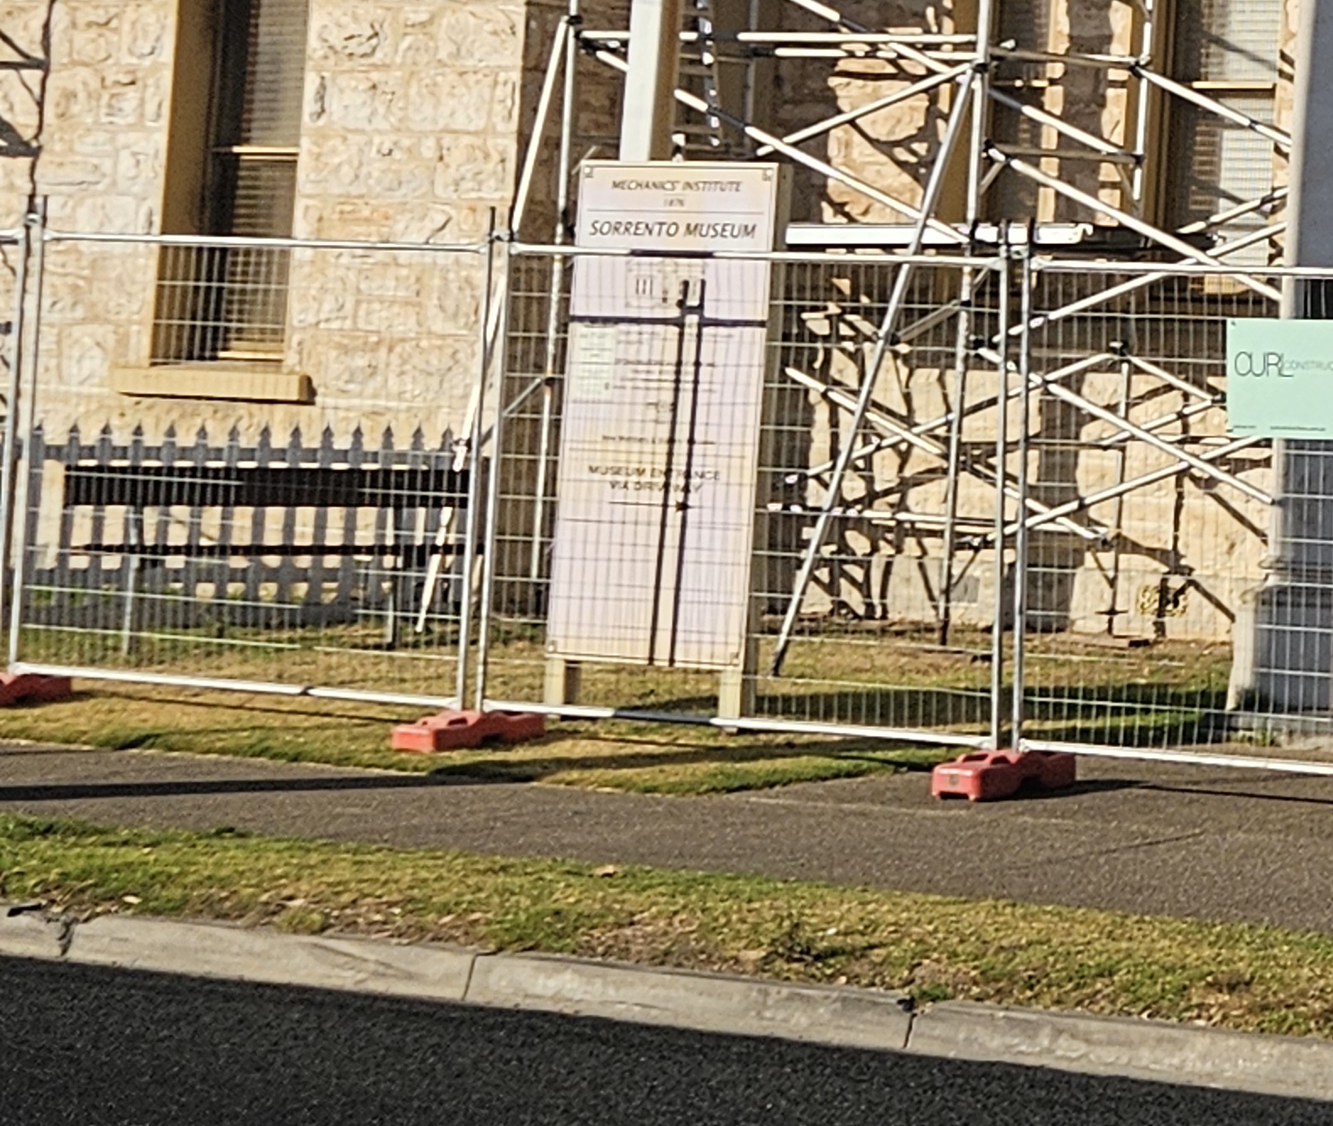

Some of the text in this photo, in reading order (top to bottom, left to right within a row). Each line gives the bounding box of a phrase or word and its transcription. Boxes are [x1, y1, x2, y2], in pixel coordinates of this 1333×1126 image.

[682, 181, 743, 192] INSTITUTE
[589, 220, 757, 239] SORRENTO MUSEUM
[588, 465, 720, 481] MUSEUM ENRNCE
